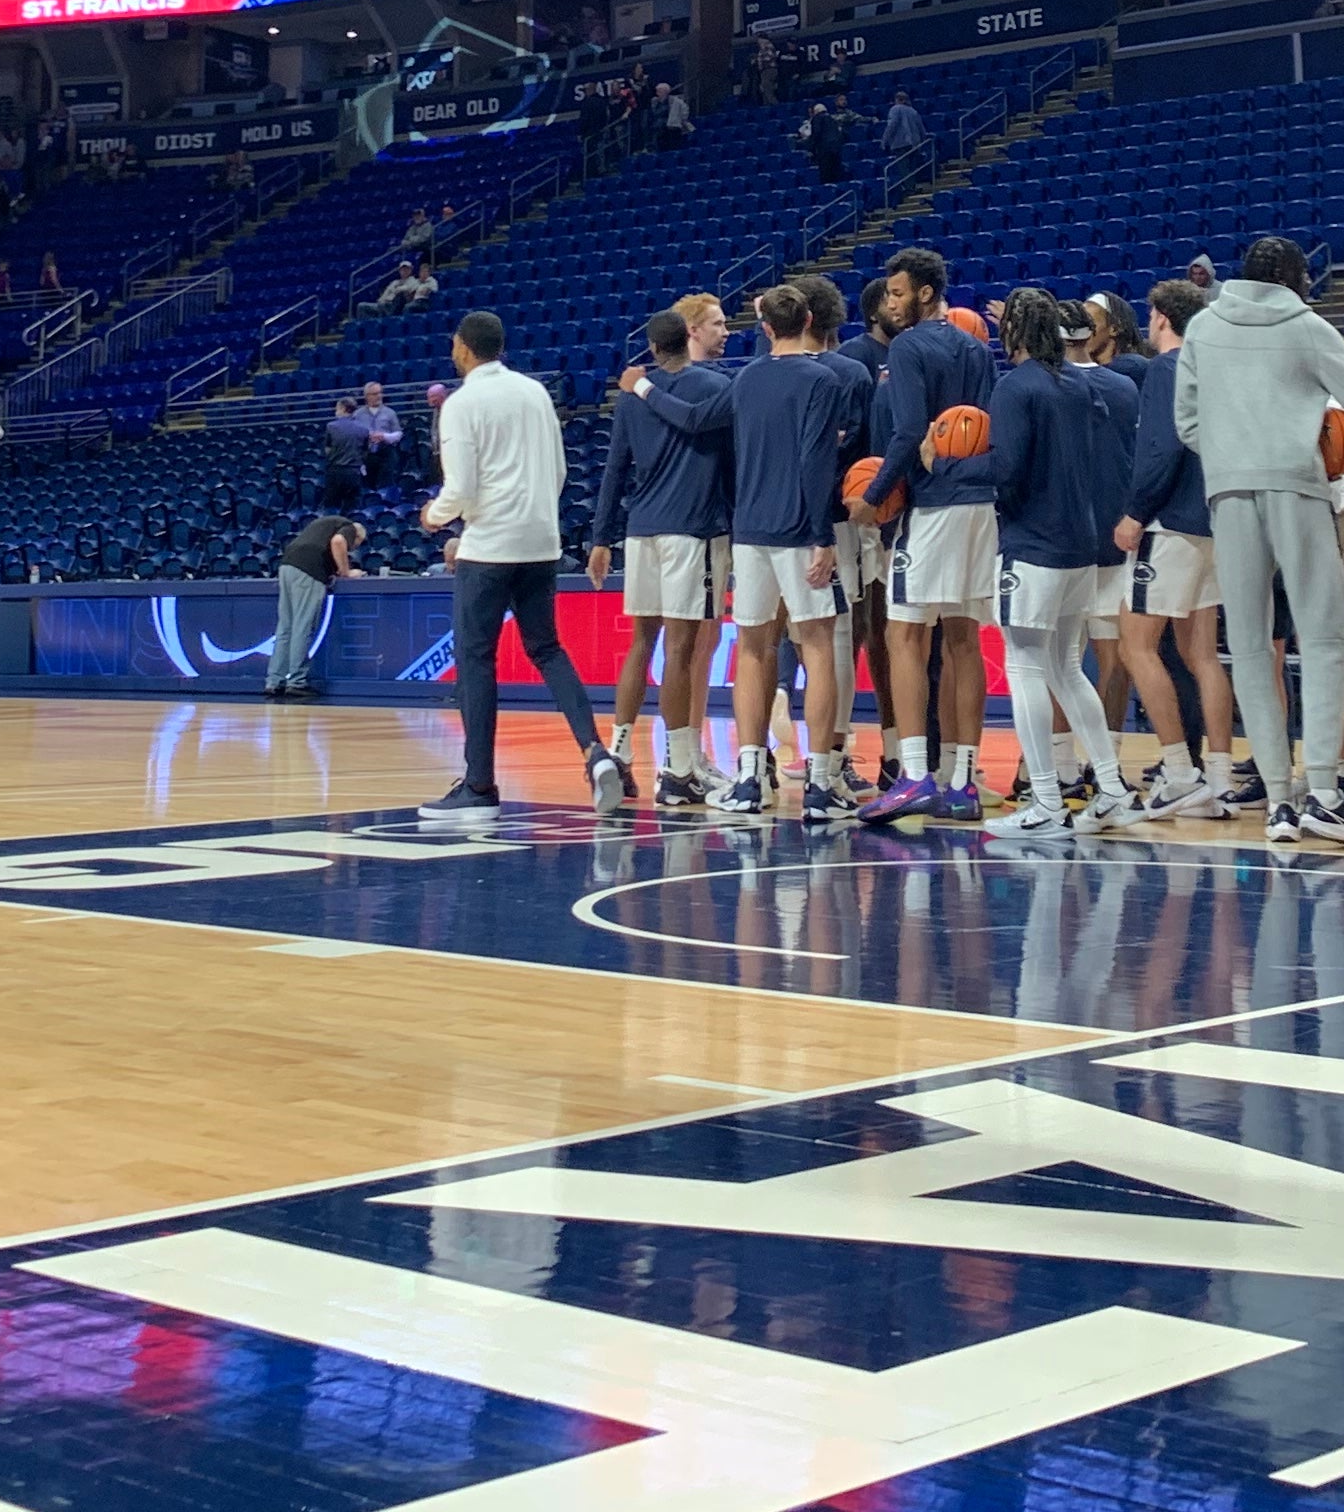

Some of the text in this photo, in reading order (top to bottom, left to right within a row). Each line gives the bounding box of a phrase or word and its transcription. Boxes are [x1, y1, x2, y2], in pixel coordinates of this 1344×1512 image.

[977, 7, 1043, 36] STATE
[413, 78, 625, 123] DEAR OLD SATE
[155, 131, 216, 151] DIDST
